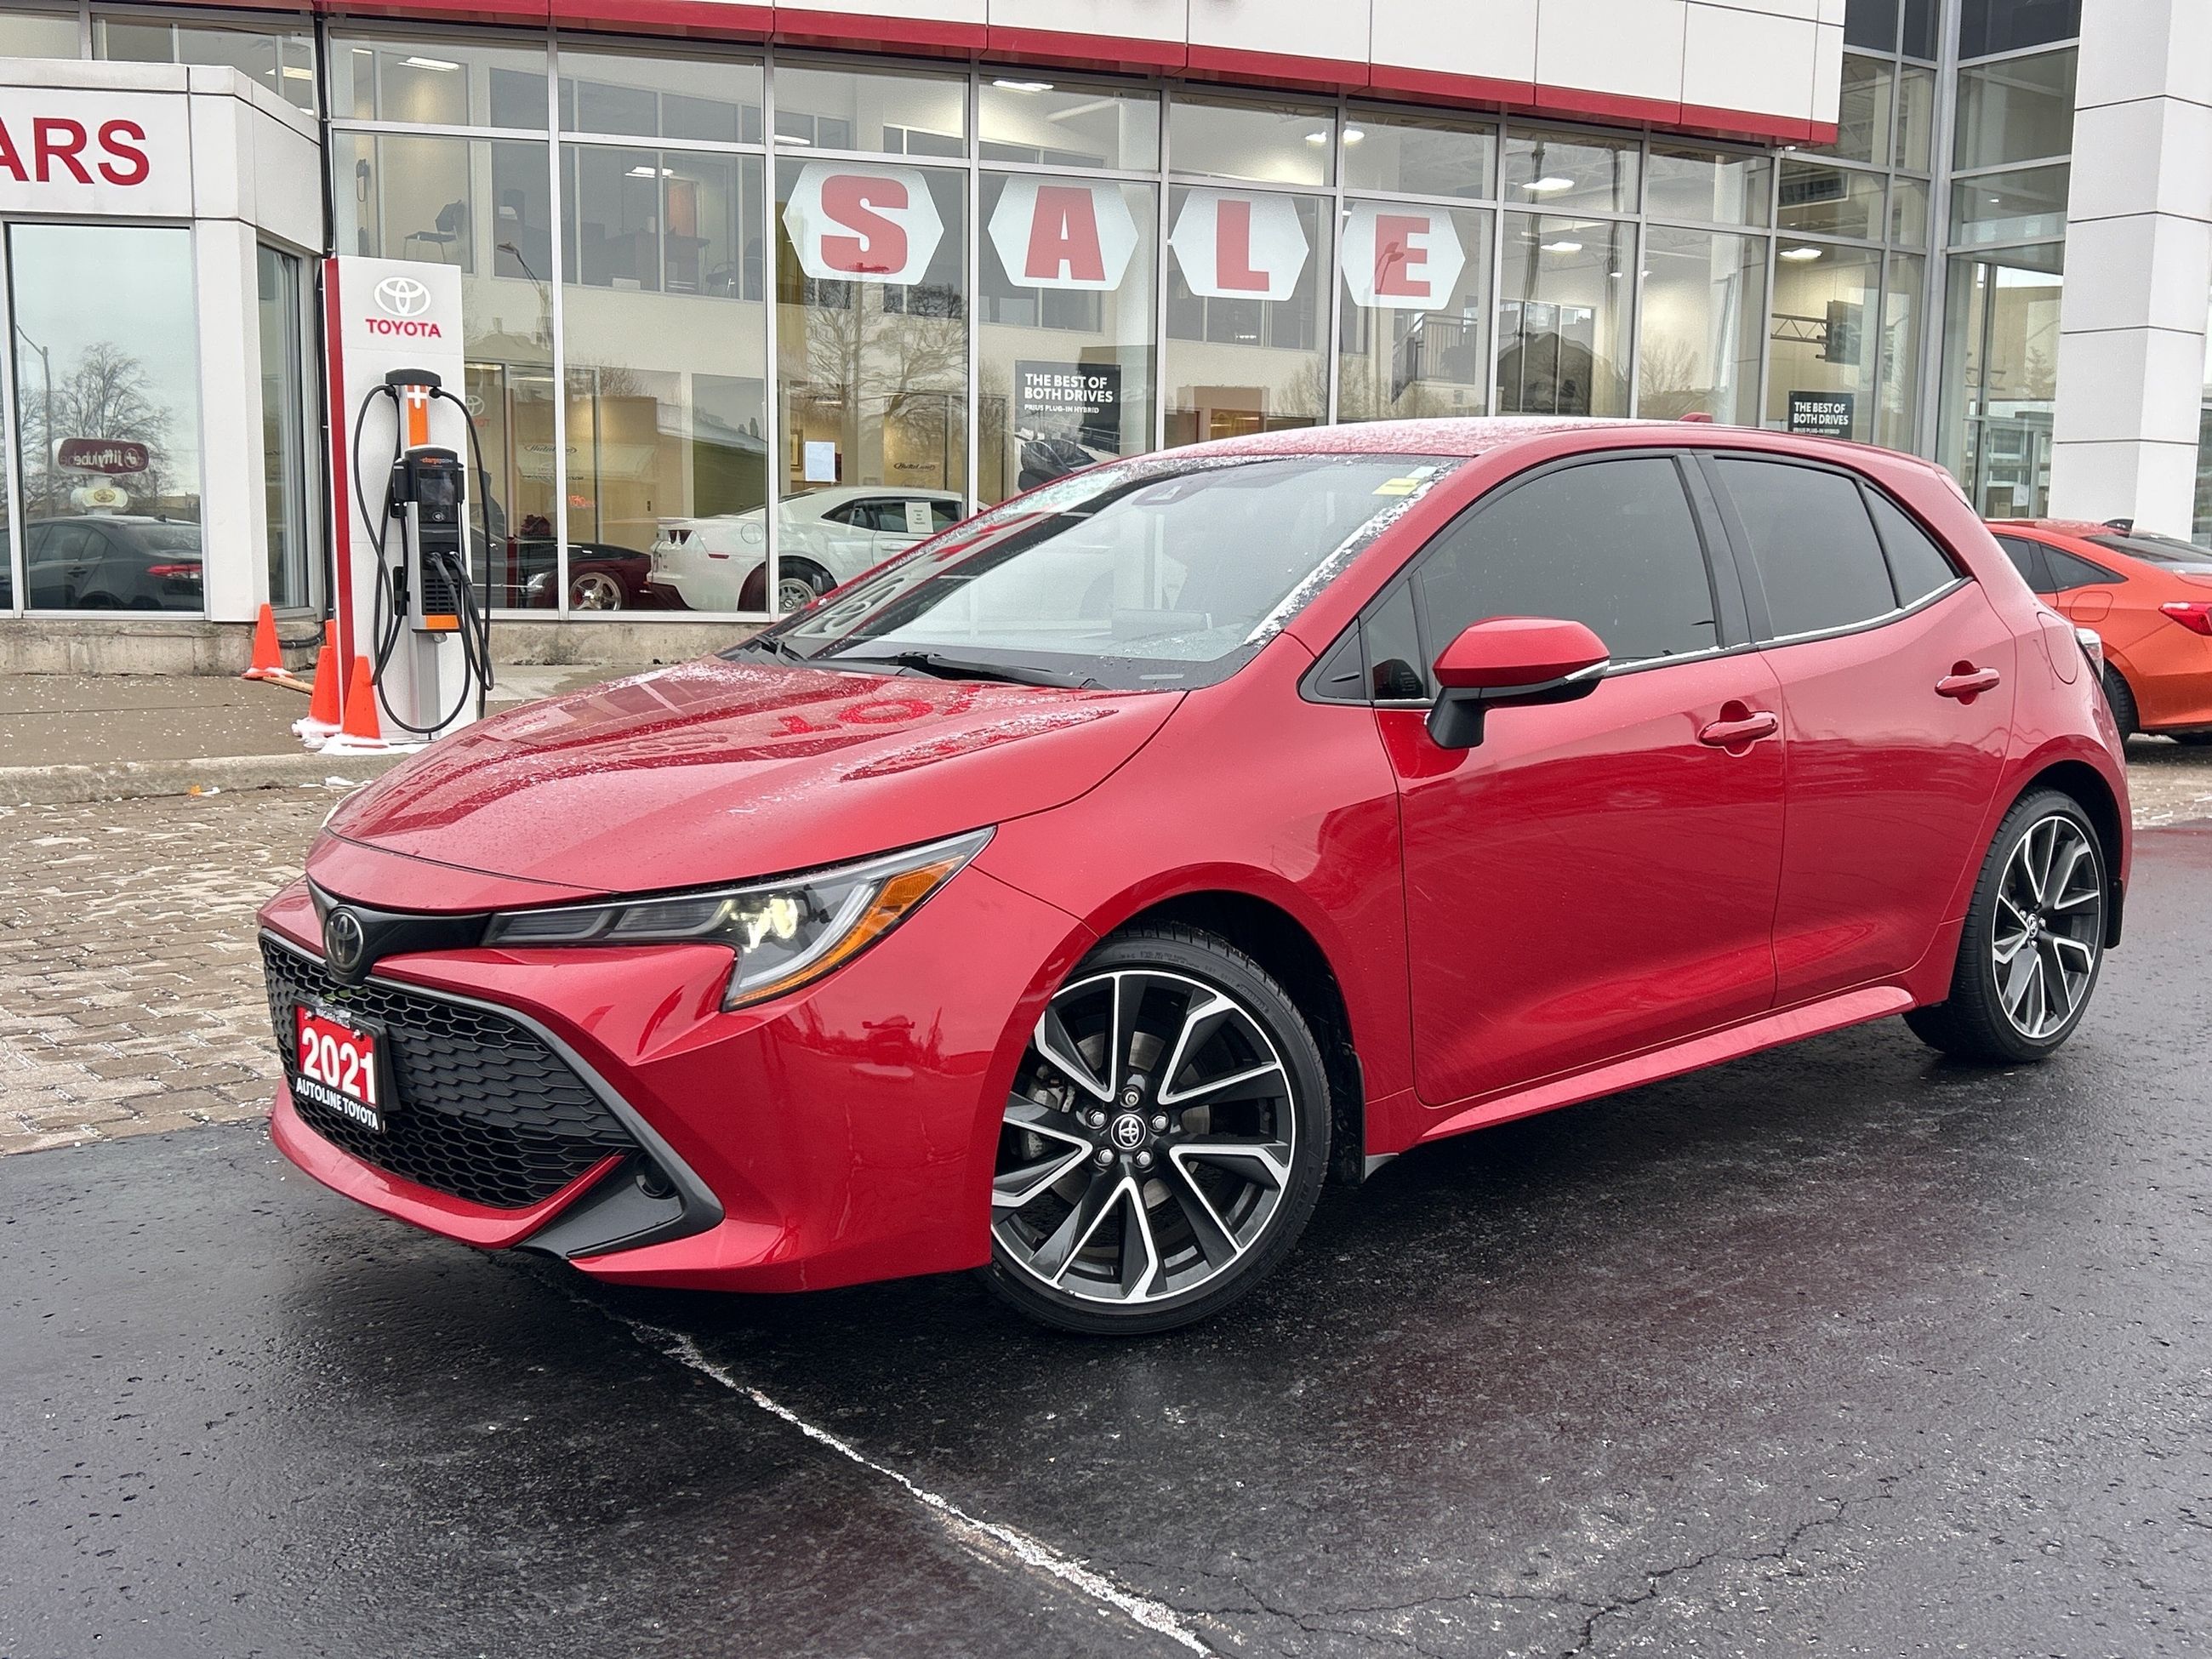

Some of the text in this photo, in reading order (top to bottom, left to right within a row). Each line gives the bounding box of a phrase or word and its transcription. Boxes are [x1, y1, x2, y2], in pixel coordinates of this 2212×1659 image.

[365, 318, 442, 338] TOYOTA
[1024, 373, 1108, 390] THE BEST OF
[1024, 387, 1114, 403] BOTH DRIVES
[1794, 401, 1846, 414] THE BEST OF
[1793, 413, 1849, 425] BOTH DRIVES
[302, 1026, 377, 1104] 2021
[296, 1078, 379, 1130] AUTOLINE TOYOTA
